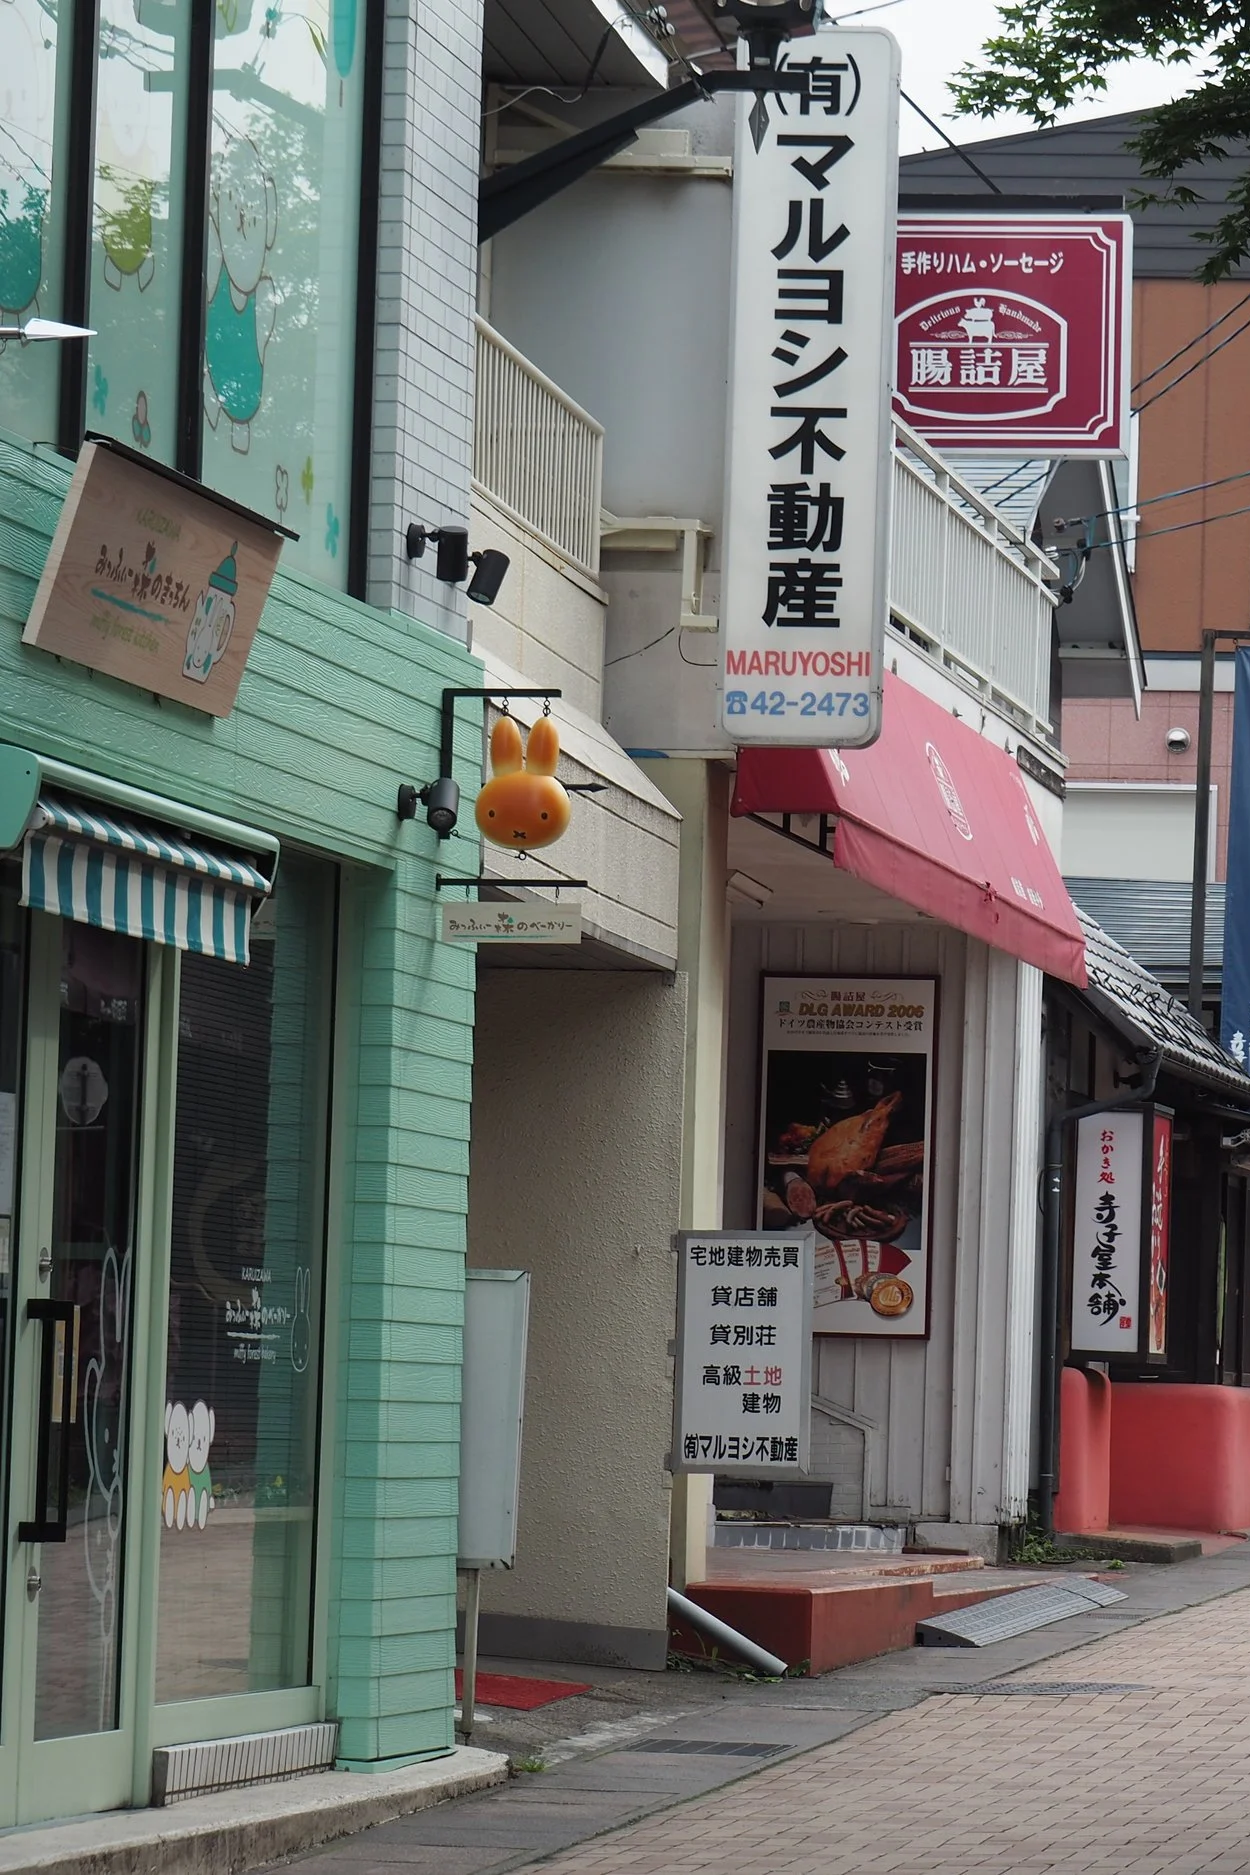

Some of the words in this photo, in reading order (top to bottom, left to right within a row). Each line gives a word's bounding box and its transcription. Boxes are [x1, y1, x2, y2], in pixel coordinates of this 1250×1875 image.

[901, 251, 1064, 275] 手作りハム・ソーセージ
[919, 305, 961, 332] Delicious
[998, 303, 1042, 333] Handmade
[911, 348, 1048, 386] 腸詰屋
[726, 650, 870, 677] MARUYOSHI
[799, 1003, 829, 1016] DLG
[831, 1004, 885, 1018] AWARD
[887, 1004, 925, 1018] 2006
[1097, 1129, 1116, 1184] おかき処
[690, 1246, 800, 1268] 宅地建物売買
[1087, 1191, 1127, 1327] 寺子屋本舗
[711, 1285, 778, 1307] 貸店舗
[709, 1324, 777, 1346] 貸別荘
[702, 1364, 782, 1387] 高級土地
[742, 1392, 782, 1414] 建物
